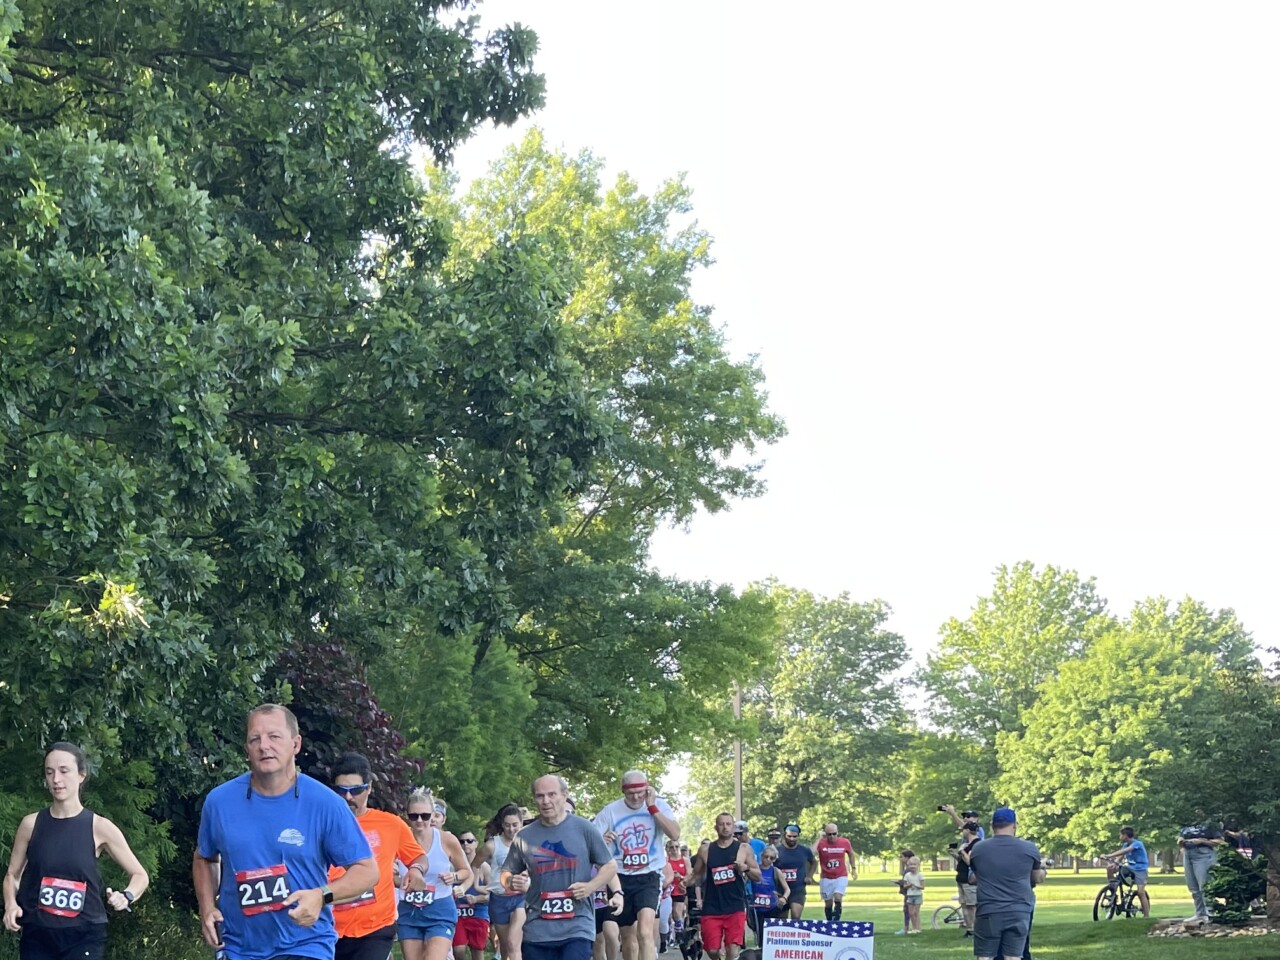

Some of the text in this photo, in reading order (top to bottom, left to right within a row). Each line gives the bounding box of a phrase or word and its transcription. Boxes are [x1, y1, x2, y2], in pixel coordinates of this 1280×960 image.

[623, 854, 648, 866] 490
[713, 869, 735, 881] 468
[238, 876, 290, 906] 214
[40, 887, 82, 911] 366
[405, 891, 434, 905] 834
[754, 896, 771, 906] 469
[541, 898, 574, 914] 428
[766, 930, 796, 939] FREEDOM
[766, 938, 833, 948] Platinum Sponsor
[774, 949, 824, 960] AMERICAN
